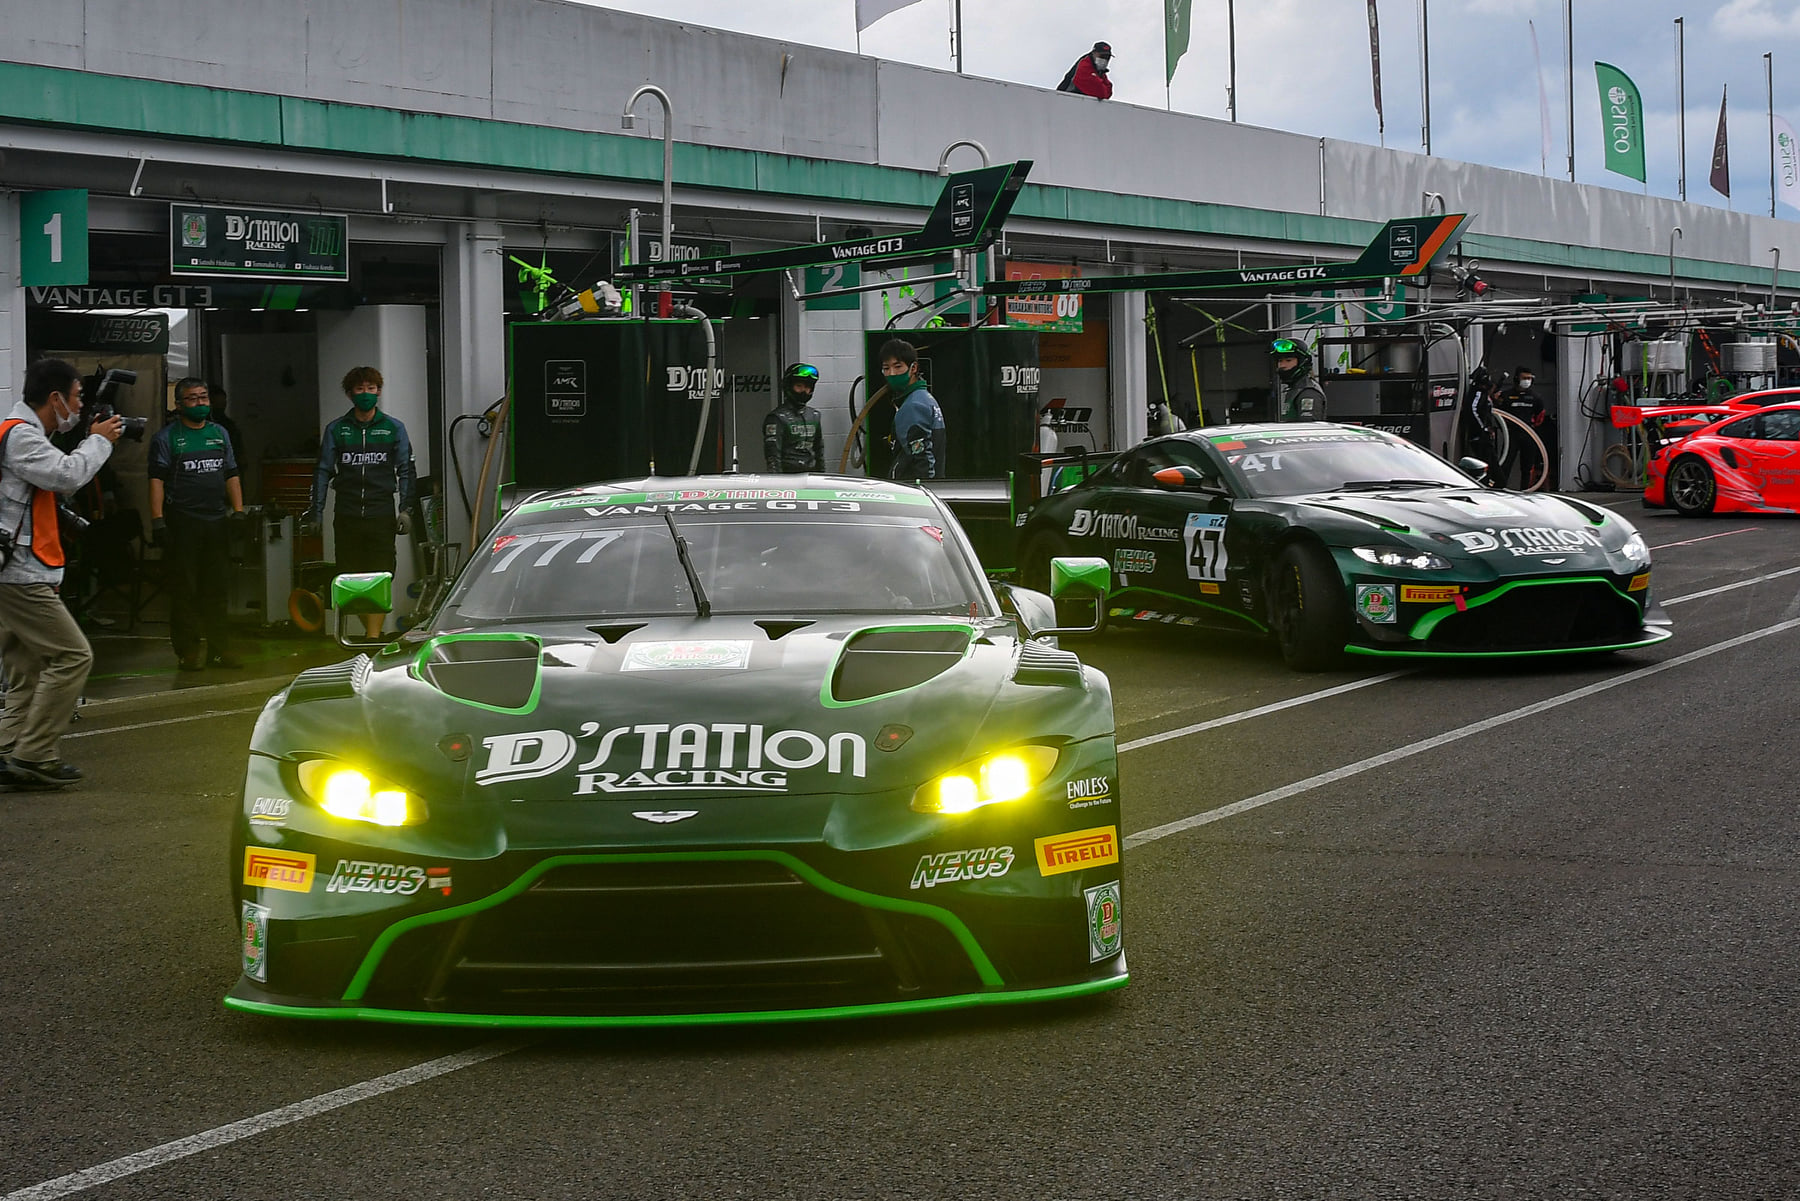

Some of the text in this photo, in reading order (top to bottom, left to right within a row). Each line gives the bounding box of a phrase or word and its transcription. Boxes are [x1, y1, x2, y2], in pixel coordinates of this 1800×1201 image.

[44, 213, 62, 263] 1
[225, 215, 300, 244] D'STATION
[245, 240, 286, 252] RACING
[648, 241, 700, 262] DTATION
[832, 238, 903, 259] VANTAGE GT3
[821, 264, 844, 292] 2
[1240, 267, 1327, 283] VANTAGE GT4
[30, 285, 212, 307] VANTAGE GT3
[552, 377, 579, 388] AMR
[688, 389, 721, 400] RACNG
[1241, 453, 1282, 472] 47
[680, 489, 797, 500] D'STATION
[583, 500, 861, 517] VANTAGE GT3
[1068, 509, 1180, 541] D'STATION RACING
[491, 530, 625, 574] 777
[1450, 527, 1603, 554] D'STATION
[1506, 545, 1587, 557] RACING
[1113, 548, 1157, 573] NEXUS
[1190, 529, 1220, 578] 47
[475, 721, 867, 786] D'STATION
[573, 770, 788, 796] RACING
[1067, 776, 1109, 799] ENDLESS
[1044, 834, 1113, 868] PIRELLI
[248, 854, 308, 884] PIRELLI
[326, 859, 427, 895] NEXUS
[910, 846, 1014, 889] NEXUS
